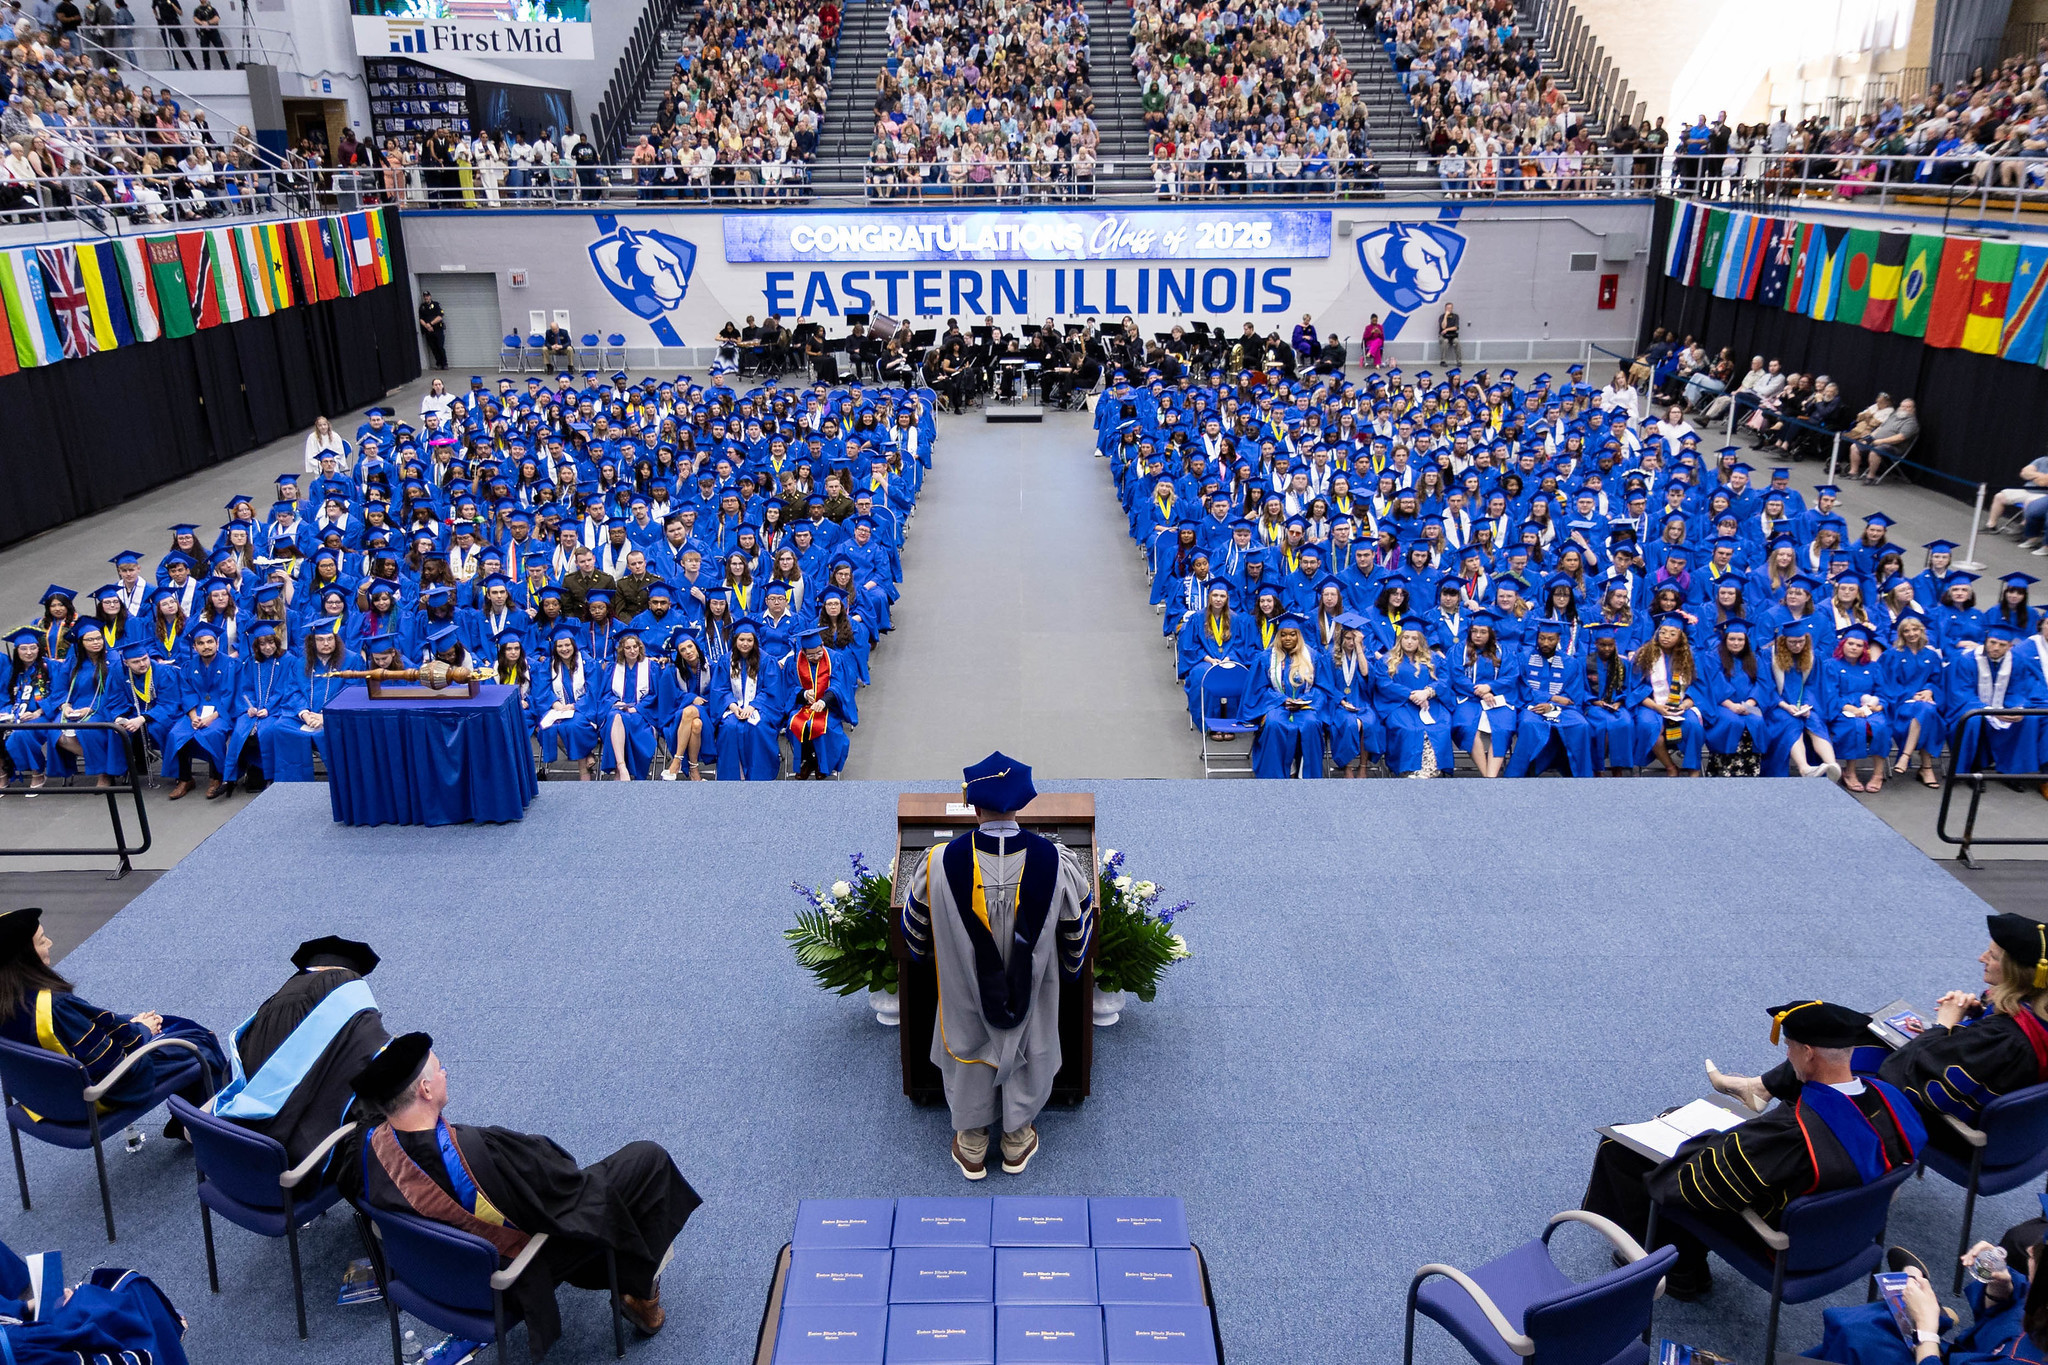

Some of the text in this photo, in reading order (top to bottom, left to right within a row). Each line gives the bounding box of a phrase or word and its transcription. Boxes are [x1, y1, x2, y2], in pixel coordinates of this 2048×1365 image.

[431, 25, 562, 53] First Mid
[790, 217, 1272, 255] CONGRATULATIONS Class of 2025
[762, 267, 1292, 316] EASTERN ILLINOIS
